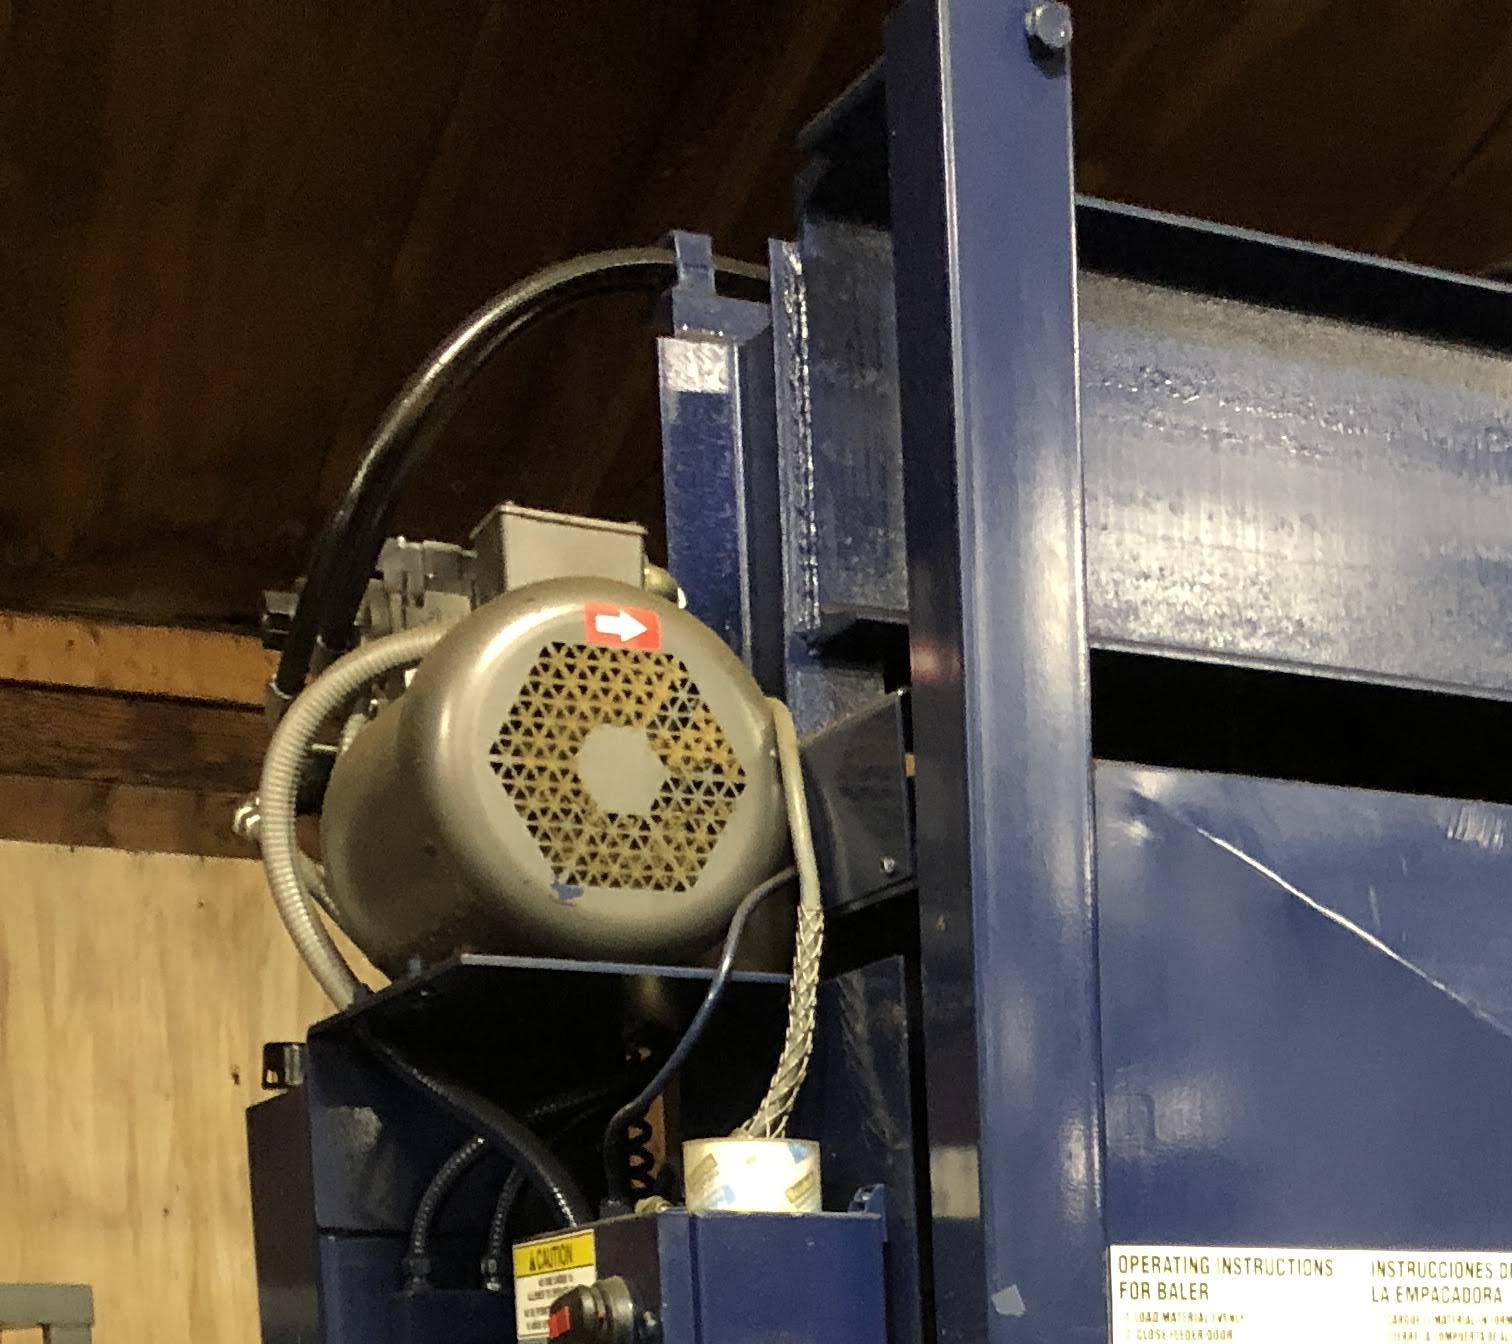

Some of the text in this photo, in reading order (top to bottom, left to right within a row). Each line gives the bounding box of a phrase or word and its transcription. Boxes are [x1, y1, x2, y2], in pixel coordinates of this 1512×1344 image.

[537, 1243, 572, 1269] CAUTION
[1118, 1255, 1334, 1277] OPERATING INSTRUCTIONS
[1371, 1260, 1494, 1279] INSTRUCCIONES
[1120, 1281, 1209, 1300] FOR BALER
[1371, 1286, 1503, 1304] LA EMPACADORA
[1163, 1311, 1208, 1323] MATERIAL
[1136, 1329, 1166, 1340] CLOSE
[1207, 1330, 1233, 1340] DOOR
